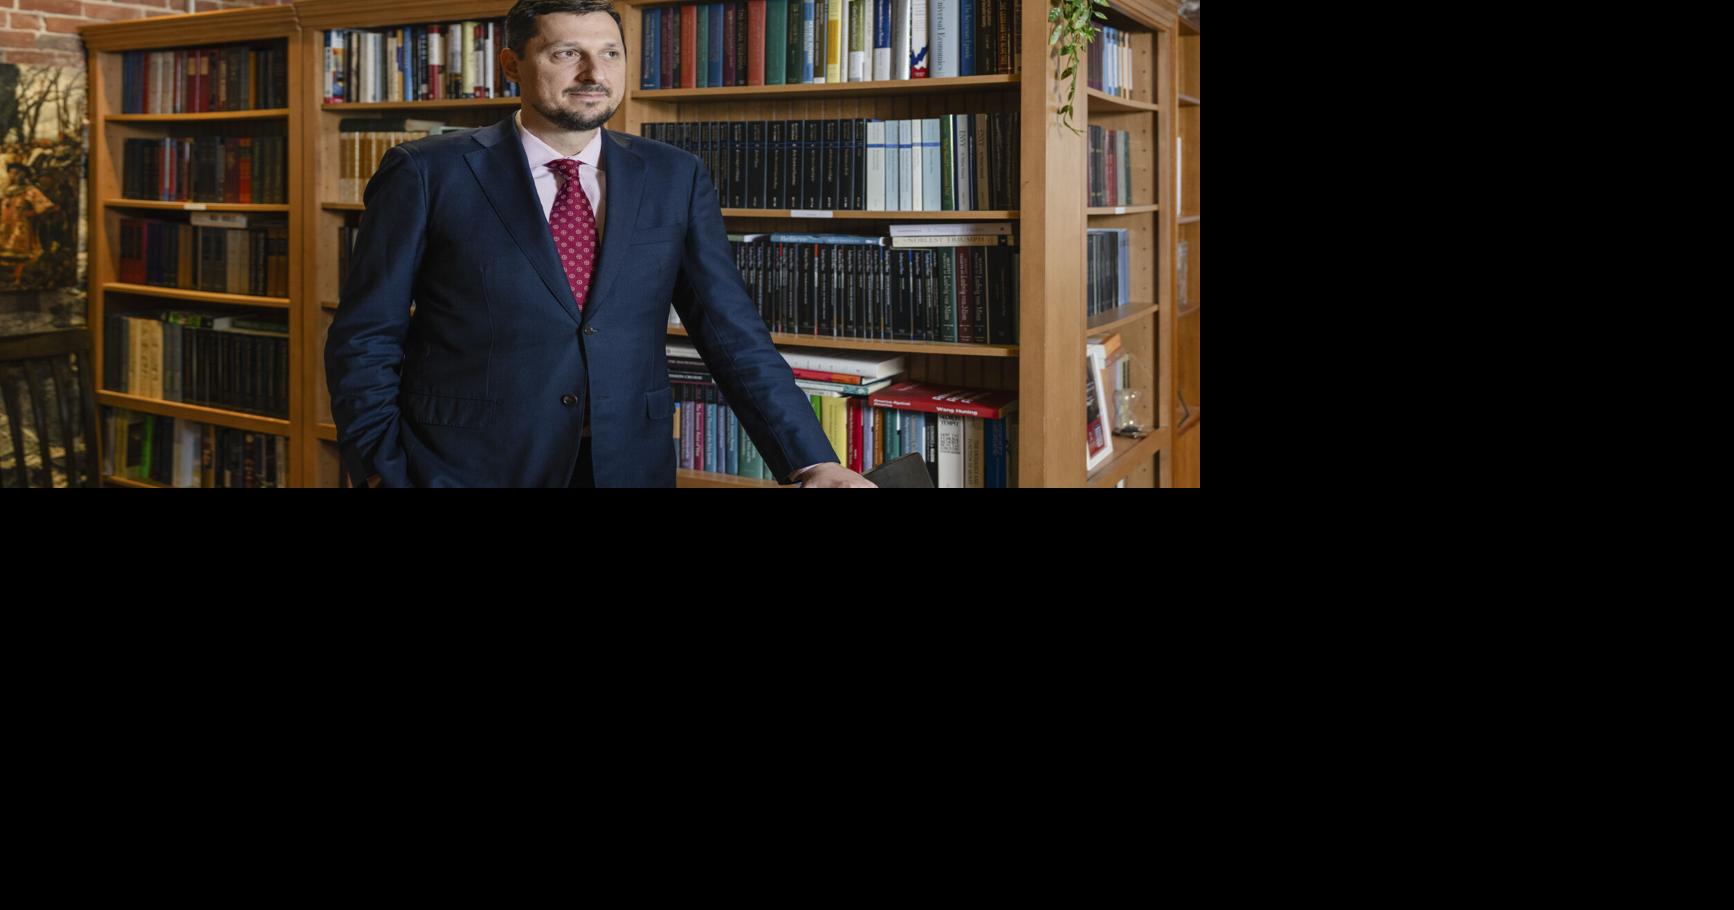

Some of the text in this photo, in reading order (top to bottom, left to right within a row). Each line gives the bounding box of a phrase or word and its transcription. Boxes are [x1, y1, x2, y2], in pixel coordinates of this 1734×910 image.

[937, 0, 946, 71] niversal Economics
[936, 406, 954, 414] Wang
